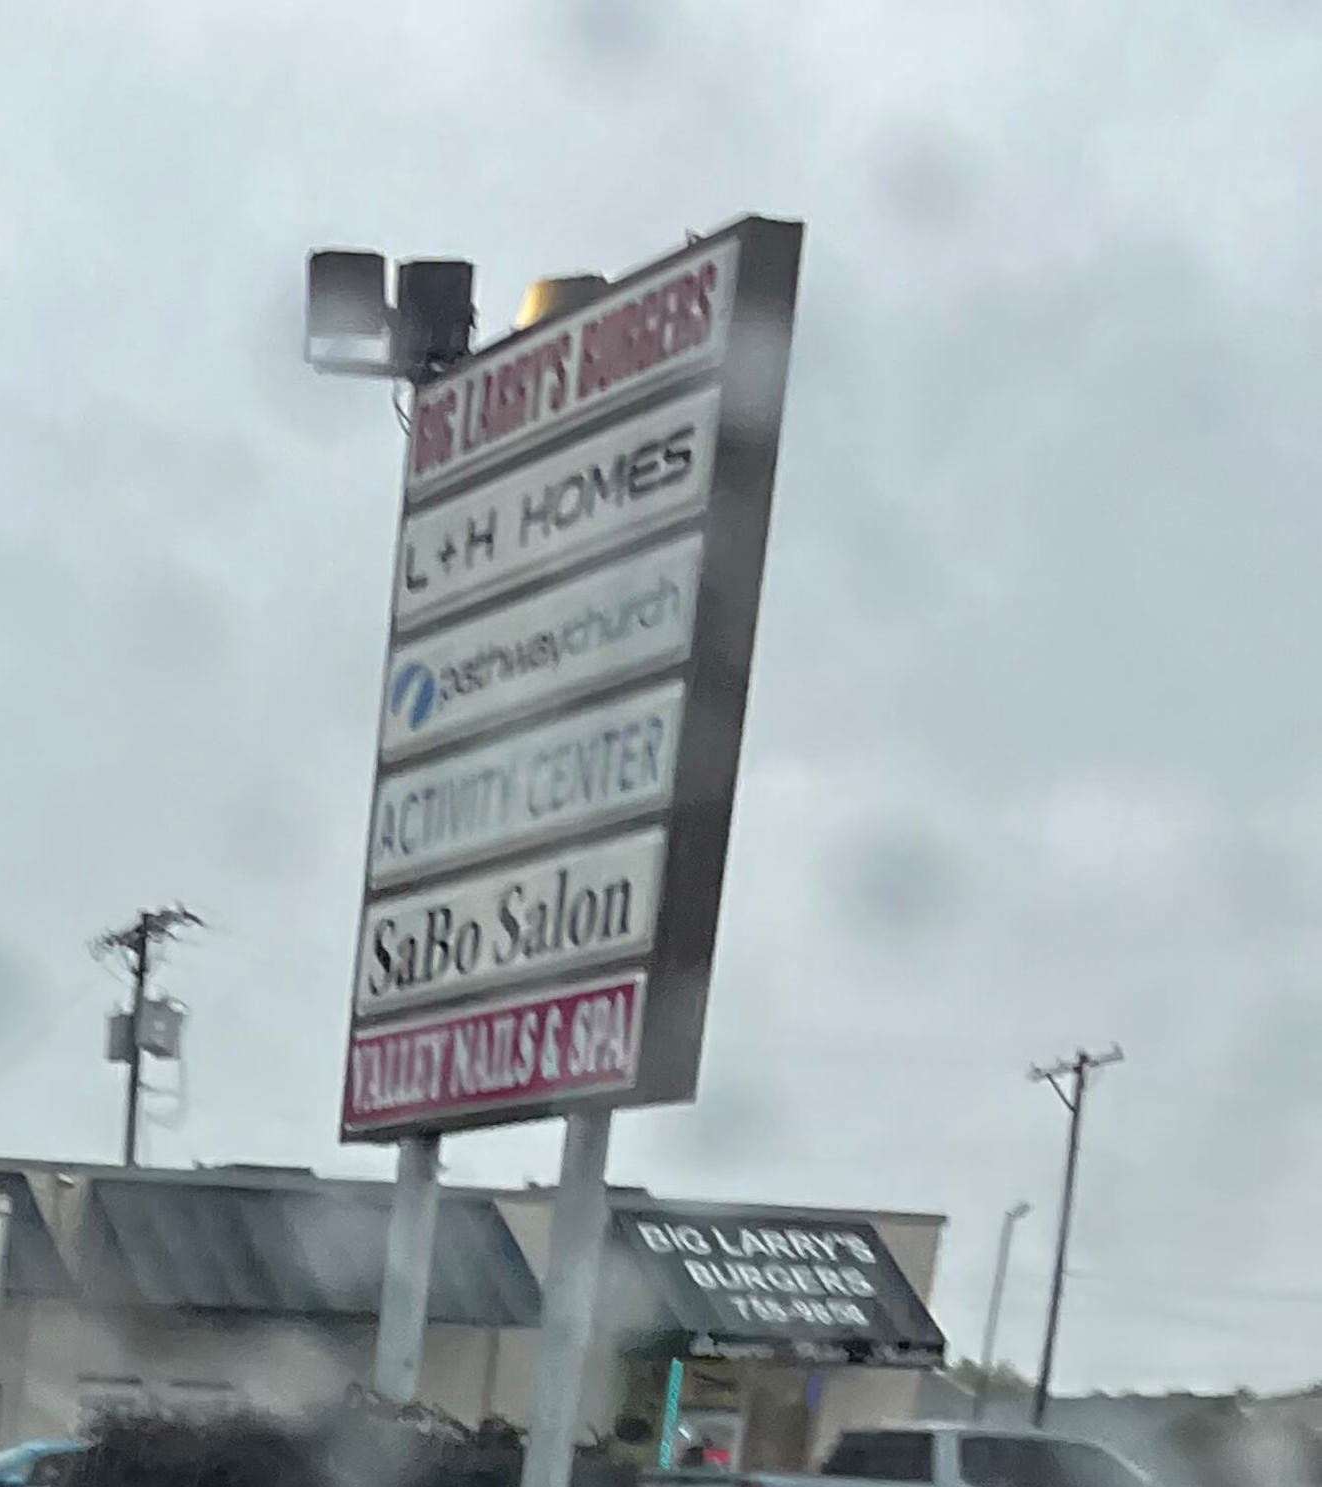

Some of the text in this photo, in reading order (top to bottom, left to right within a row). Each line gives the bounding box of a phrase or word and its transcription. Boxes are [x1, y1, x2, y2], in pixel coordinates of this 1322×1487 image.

[519, 423, 695, 549] HOMES
[526, 716, 664, 818] CENTER
[368, 869, 631, 996] SaBo Salon
[450, 1009, 539, 1097] NAILS
[568, 991, 630, 1077] SPA
[636, 1221, 877, 1265] BIG LARRY'S
[683, 1258, 878, 1299] BURGERS
